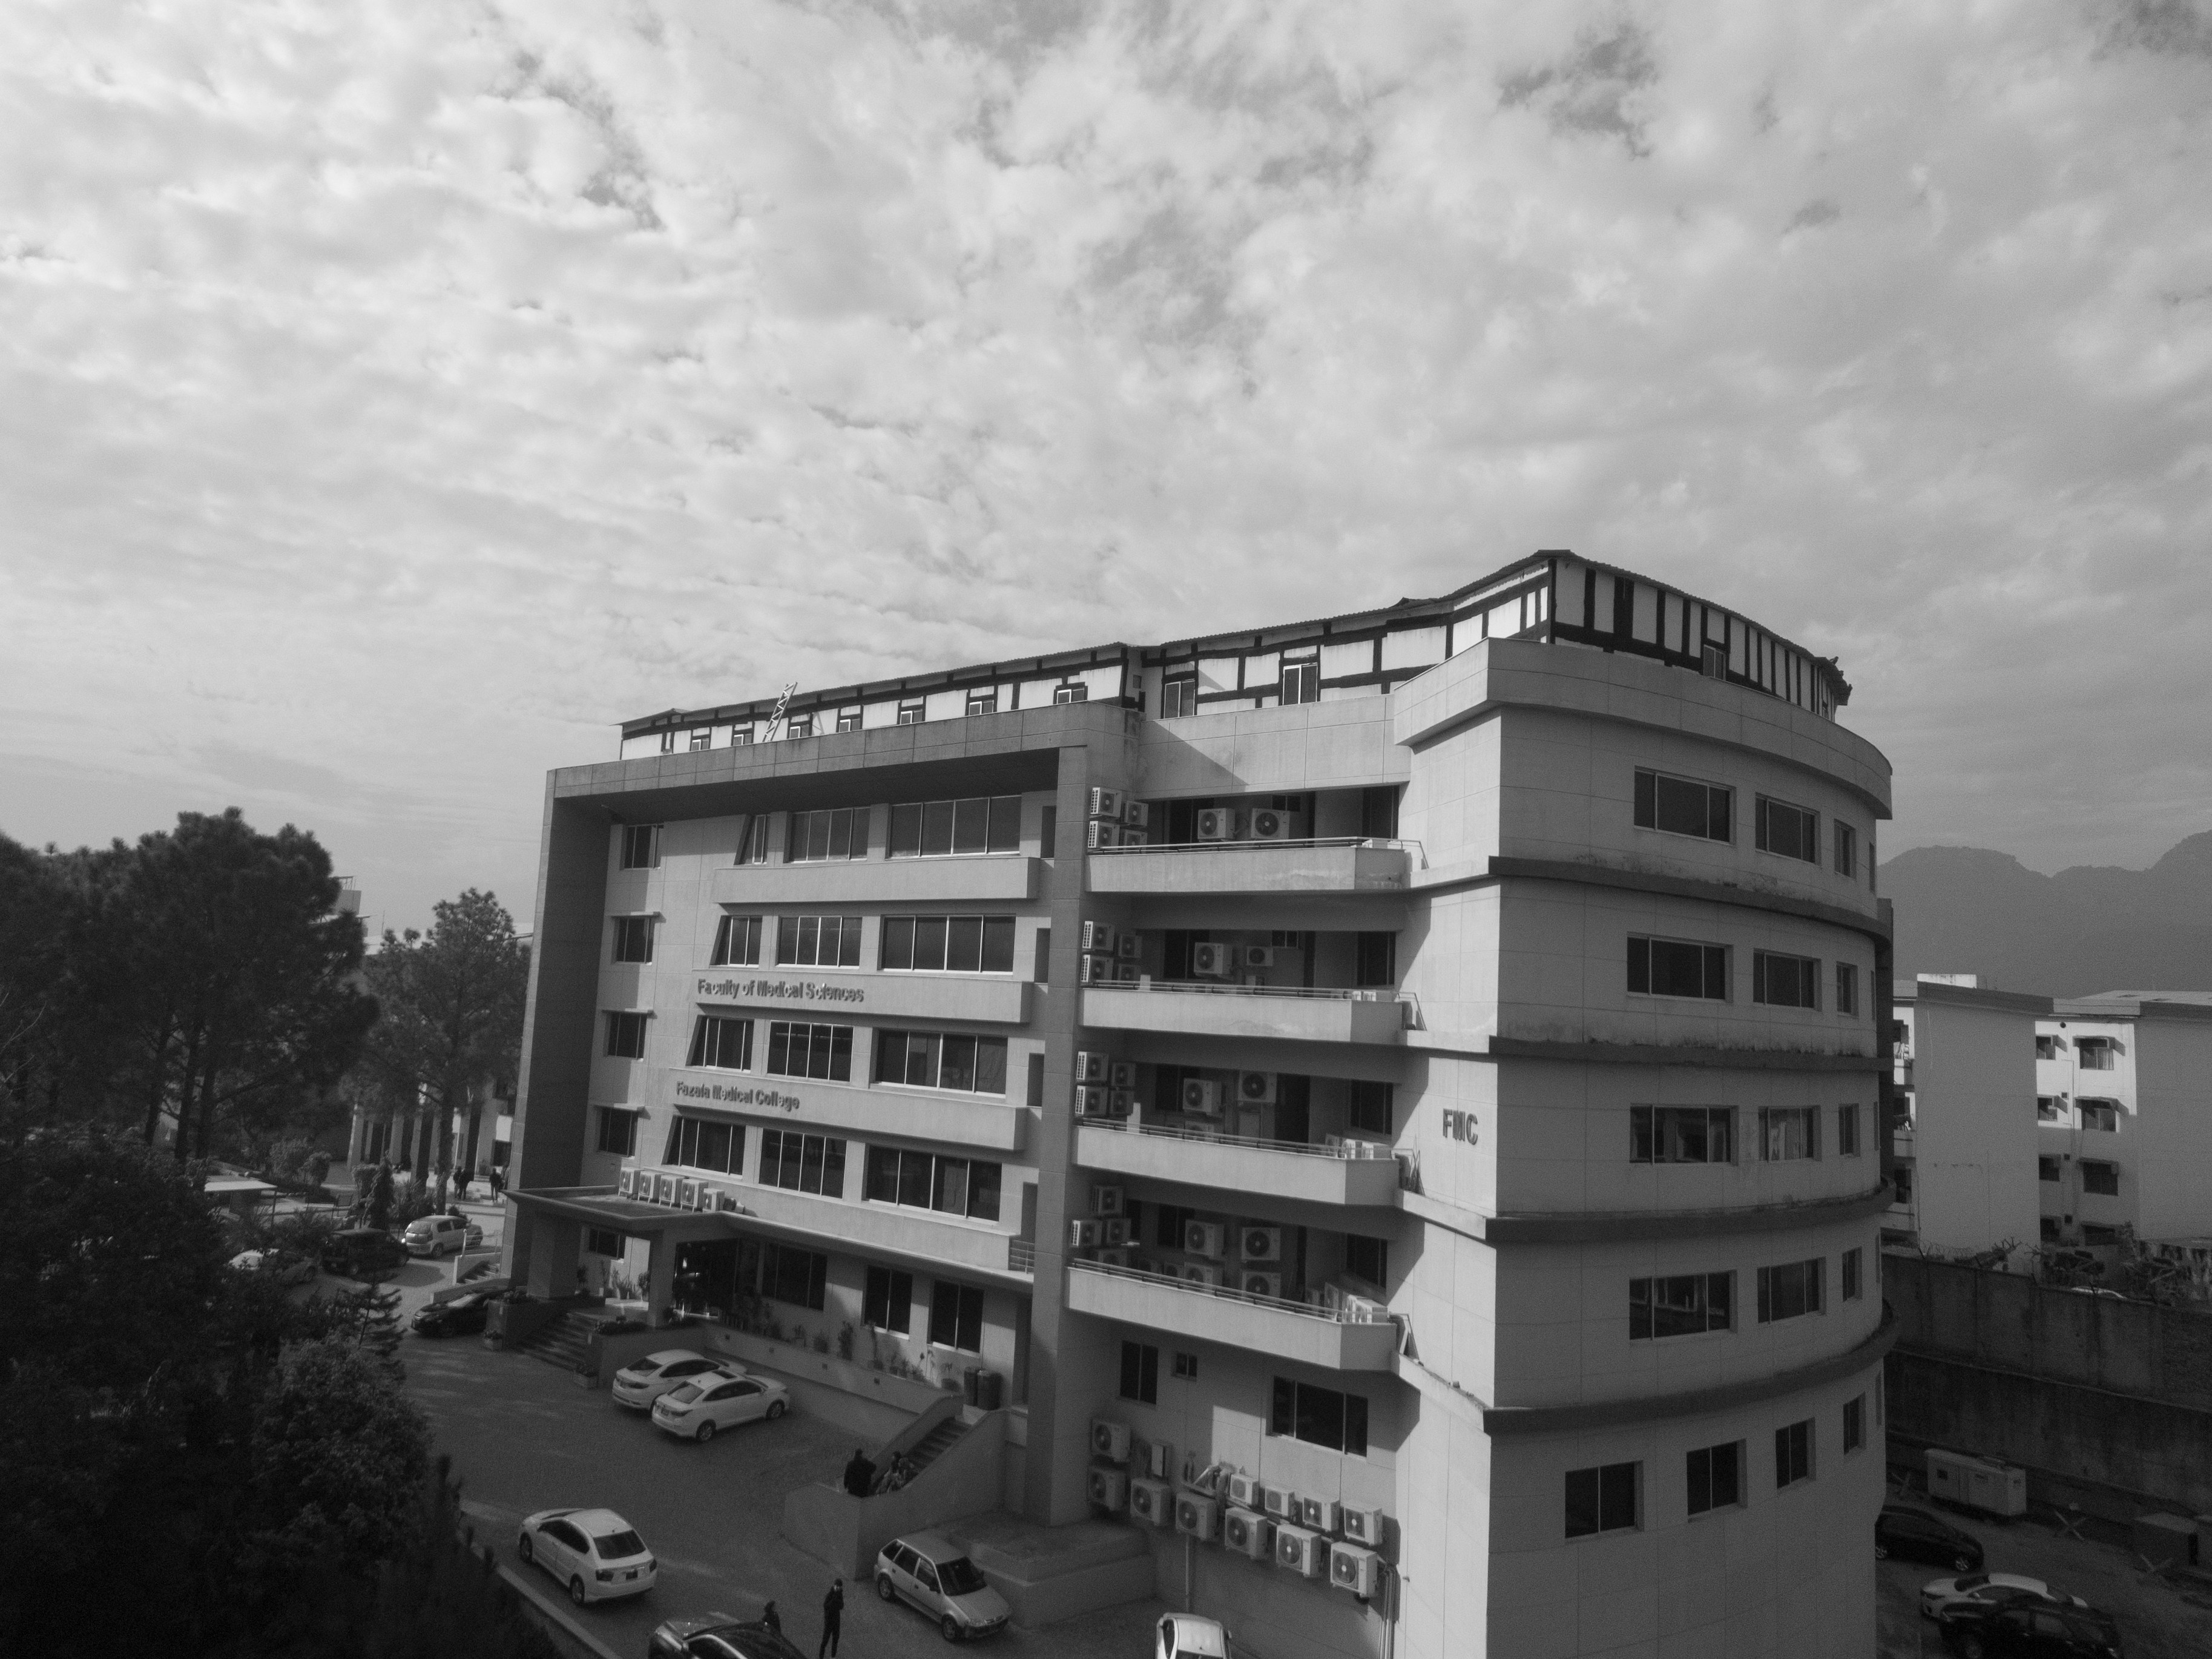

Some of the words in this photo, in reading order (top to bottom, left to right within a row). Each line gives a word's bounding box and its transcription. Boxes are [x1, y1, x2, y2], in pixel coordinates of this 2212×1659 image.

[698, 978, 740, 998] Faculty
[742, 980, 755, 996] of
[757, 980, 803, 999] Medical
[806, 981, 864, 1002] Sciences
[713, 1084, 752, 1104] Medical
[755, 1089, 800, 1112] College
[1443, 1108, 1478, 1146] FMC
